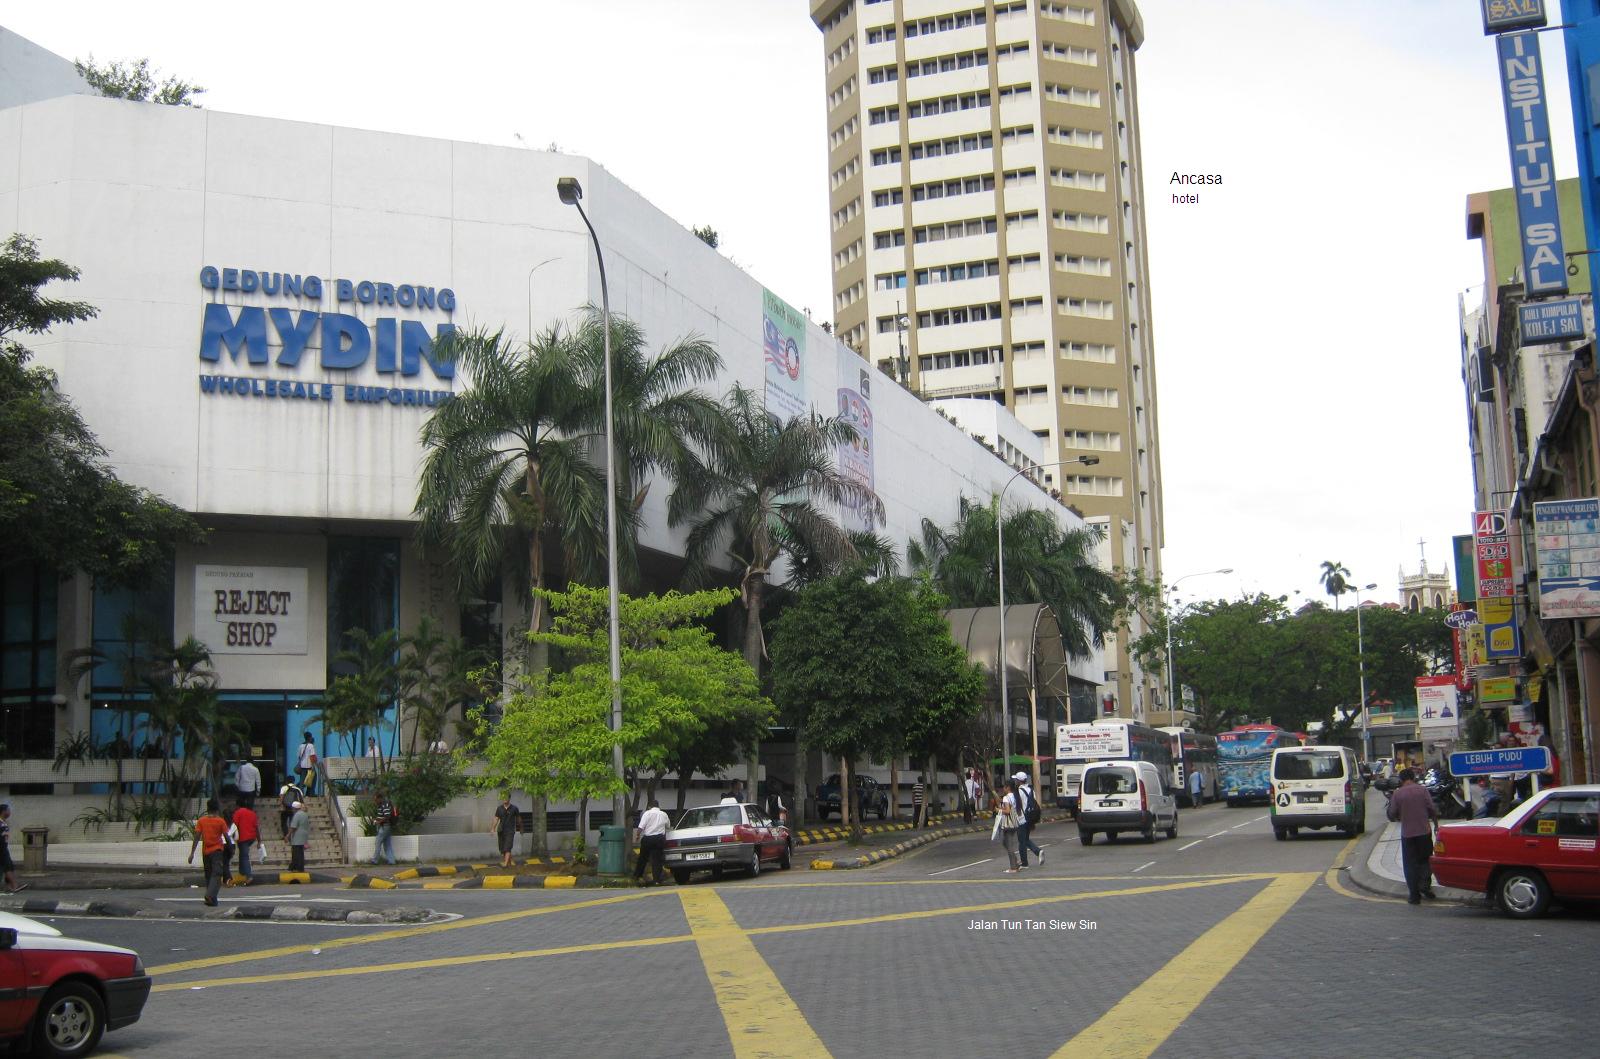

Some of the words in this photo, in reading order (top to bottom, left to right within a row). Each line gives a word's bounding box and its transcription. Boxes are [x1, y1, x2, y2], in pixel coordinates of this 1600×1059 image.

[1505, 36, 1550, 208] INSTITUT
[1526, 223, 1562, 290] SAL
[200, 265, 322, 301] GEDUNG
[336, 278, 456, 312] BORONG
[1524, 308, 1539, 320] AHLI
[1542, 304, 1578, 318] KUMPULAN
[1525, 320, 1556, 337] KOLEJ
[1560, 317, 1579, 333] SAL
[199, 302, 456, 380] MYDIN
[199, 374, 333, 401] WHOLESALE
[344, 385, 456, 408] EMPORIUM
[1478, 514, 1506, 535] 4D
[214, 590, 291, 616] REJECT
[1447, 612, 1466, 623] Hari
[226, 621, 278, 647] SHOP
[1465, 753, 1493, 765] LEBUH
[1498, 751, 1523, 762] PUDU
[1279, 793, 1289, 805] A
